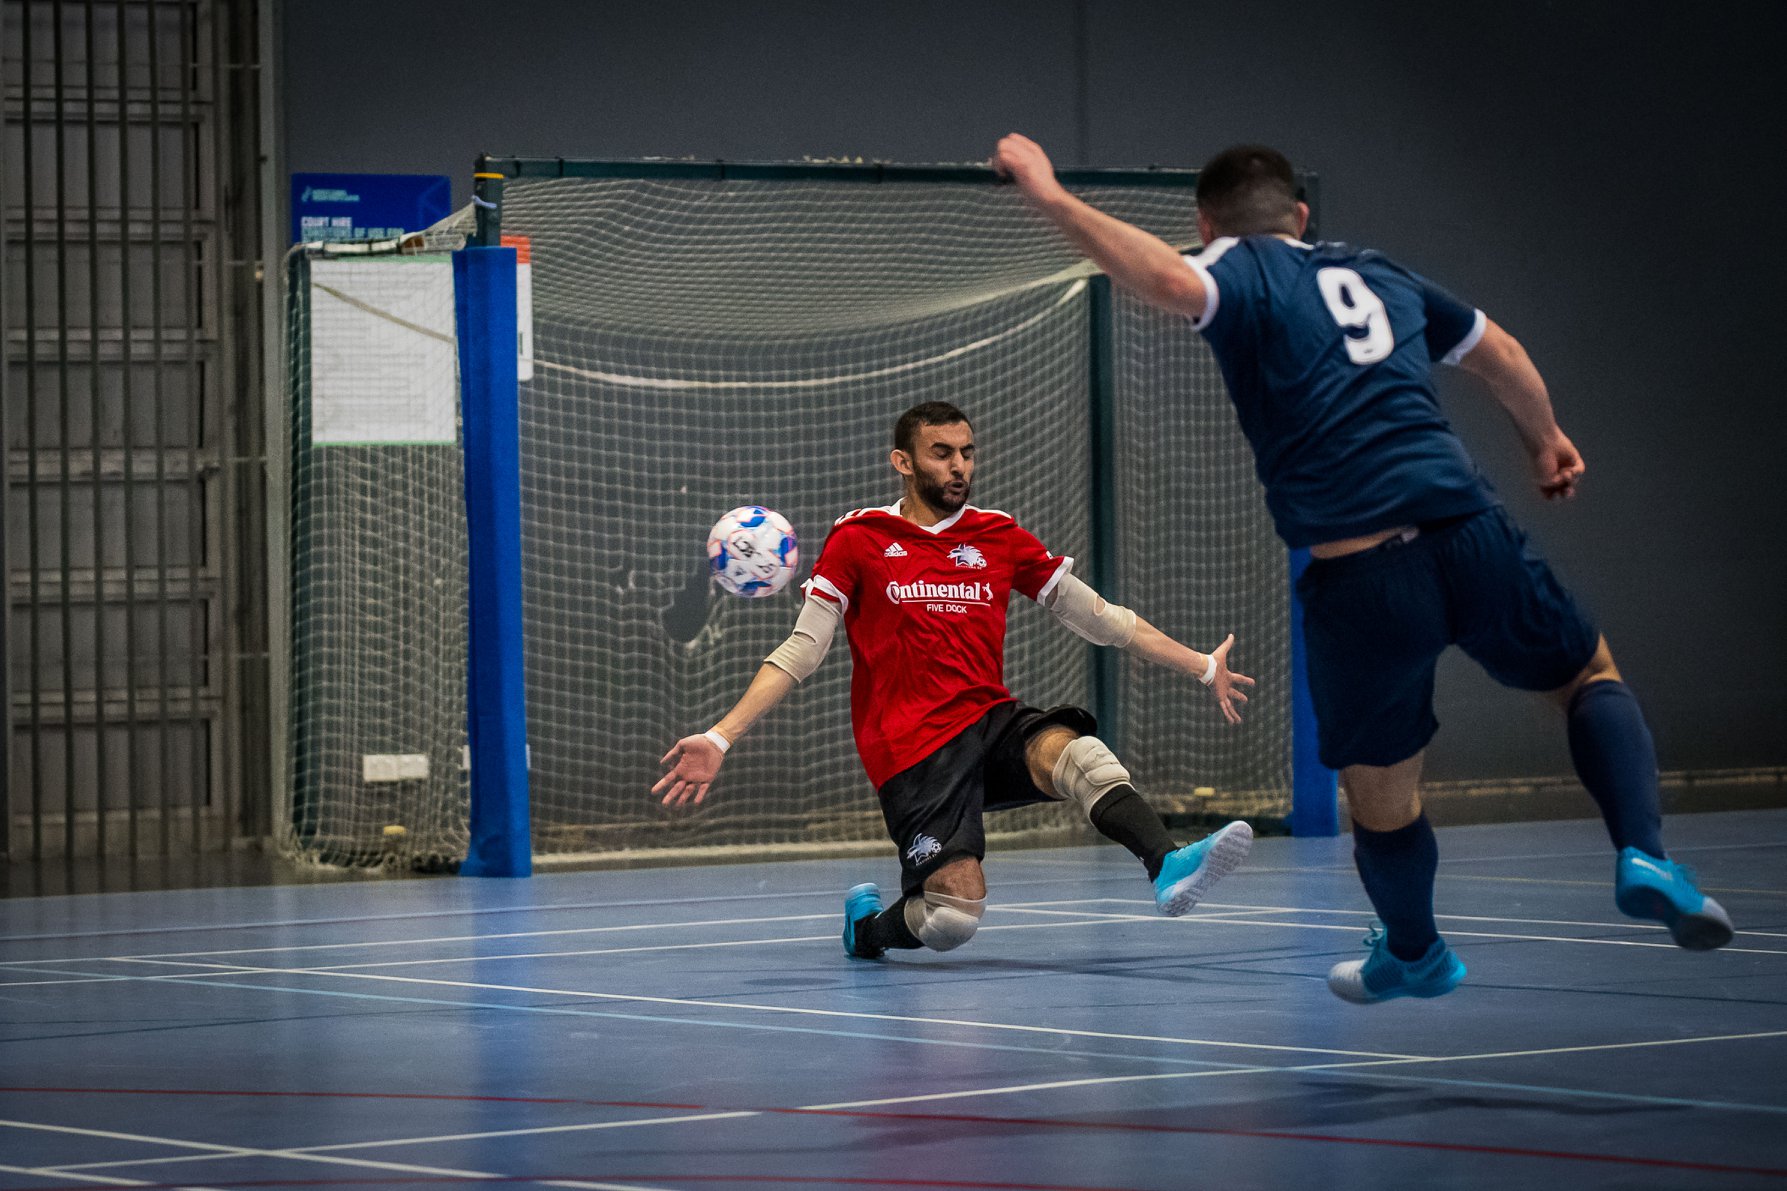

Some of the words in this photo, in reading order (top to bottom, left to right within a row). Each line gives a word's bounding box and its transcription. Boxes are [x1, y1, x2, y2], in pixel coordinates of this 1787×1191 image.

[1317, 267, 1394, 365] 9
[884, 550, 908, 558] adidas
[886, 580, 980, 605] Continental
[926, 604, 944, 612] FIVE
[946, 604, 967, 613] DOCK
